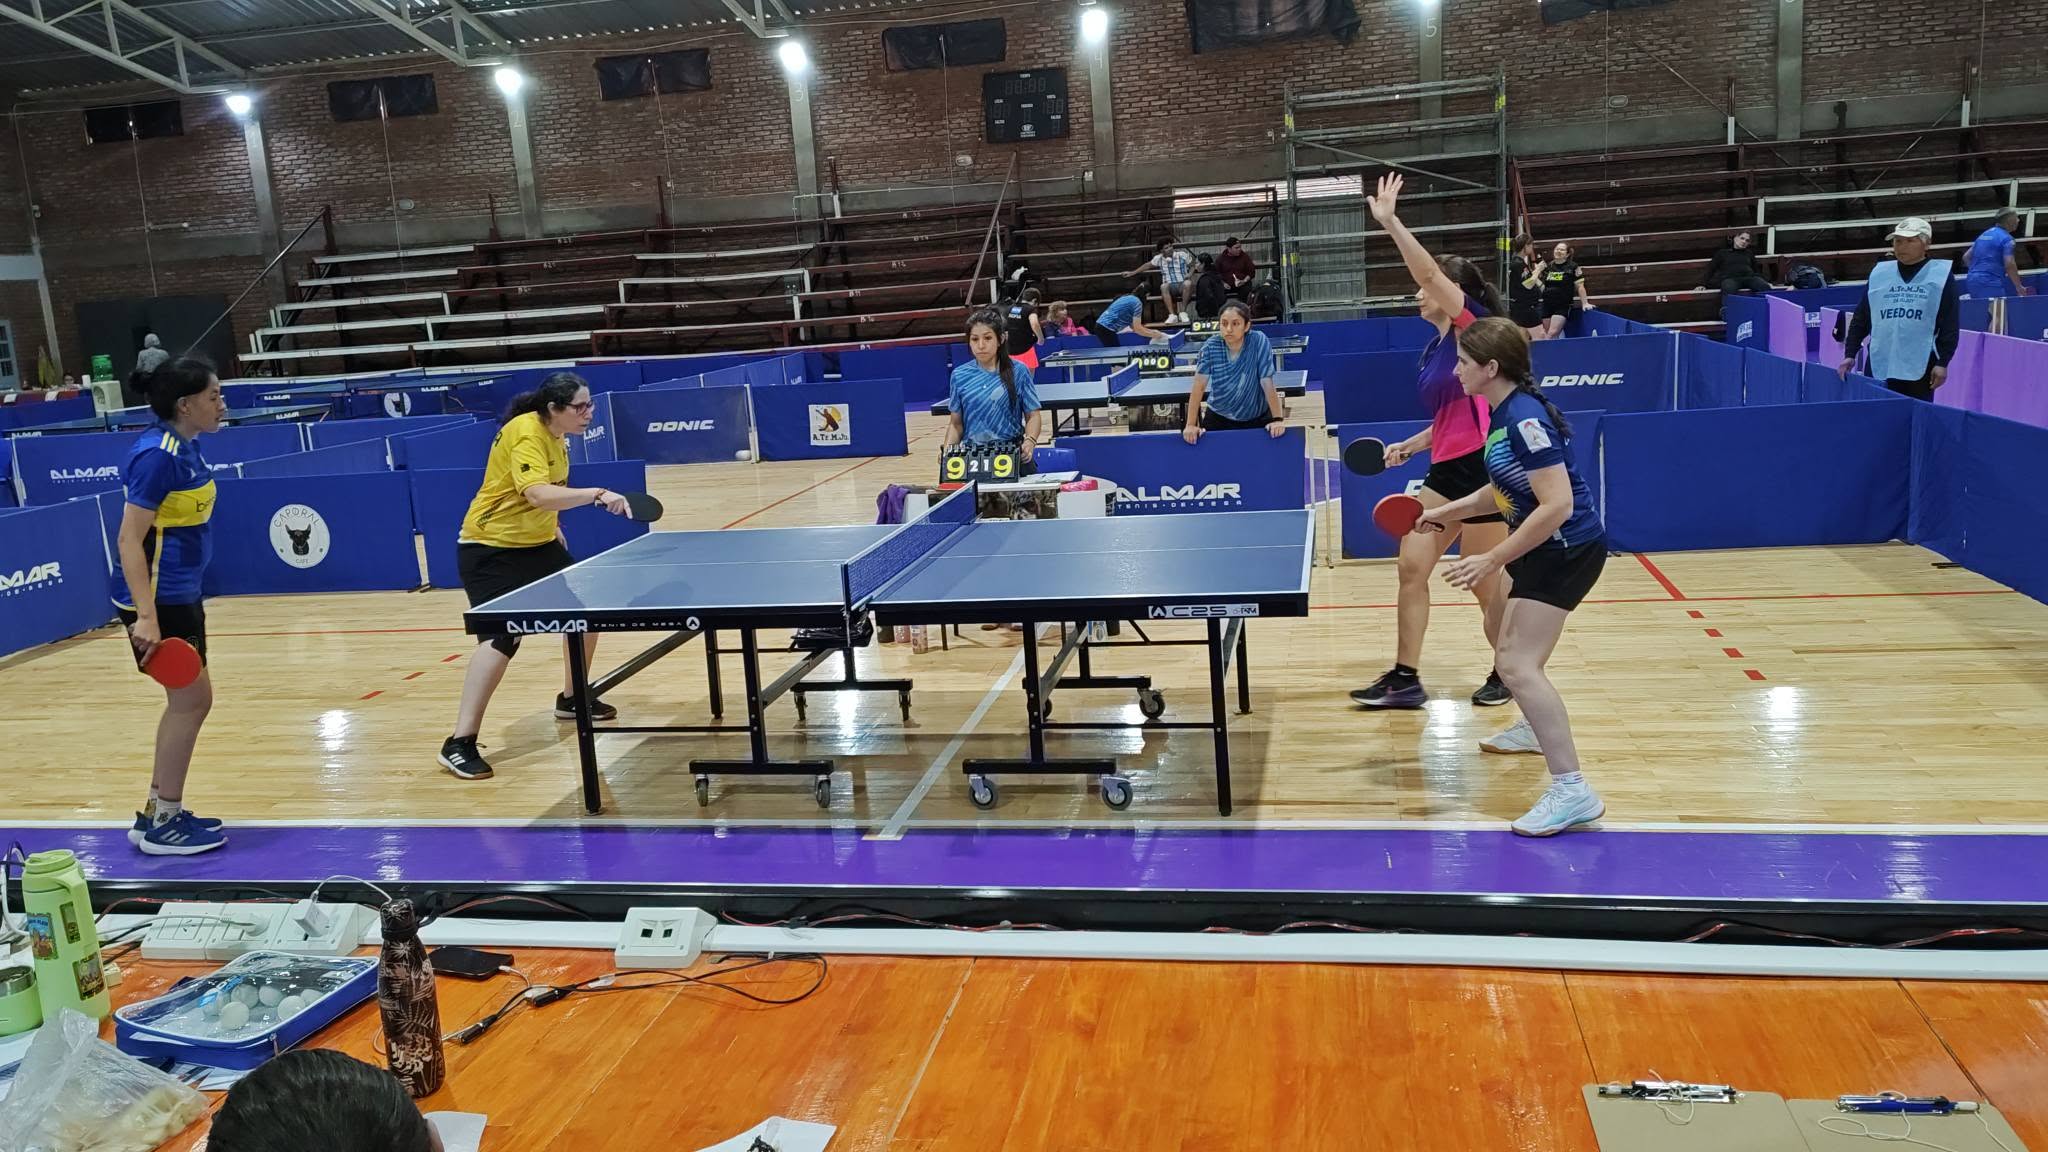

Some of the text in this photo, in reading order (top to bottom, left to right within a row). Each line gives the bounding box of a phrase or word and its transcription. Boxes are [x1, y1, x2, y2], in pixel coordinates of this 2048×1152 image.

[1425, 17, 1437, 38] 5
[1880, 308, 1923, 320] VEEDOR
[1540, 373, 1624, 387] DONIC
[647, 419, 715, 433] DONIC
[50, 466, 120, 480] ALMAR
[947, 454, 1013, 480] 9 2 1 9
[1116, 483, 1242, 502] ALMAR
[273, 507, 320, 528] CAPORAL
[0, 561, 61, 591] MAR
[506, 619, 588, 634] ALMAR
